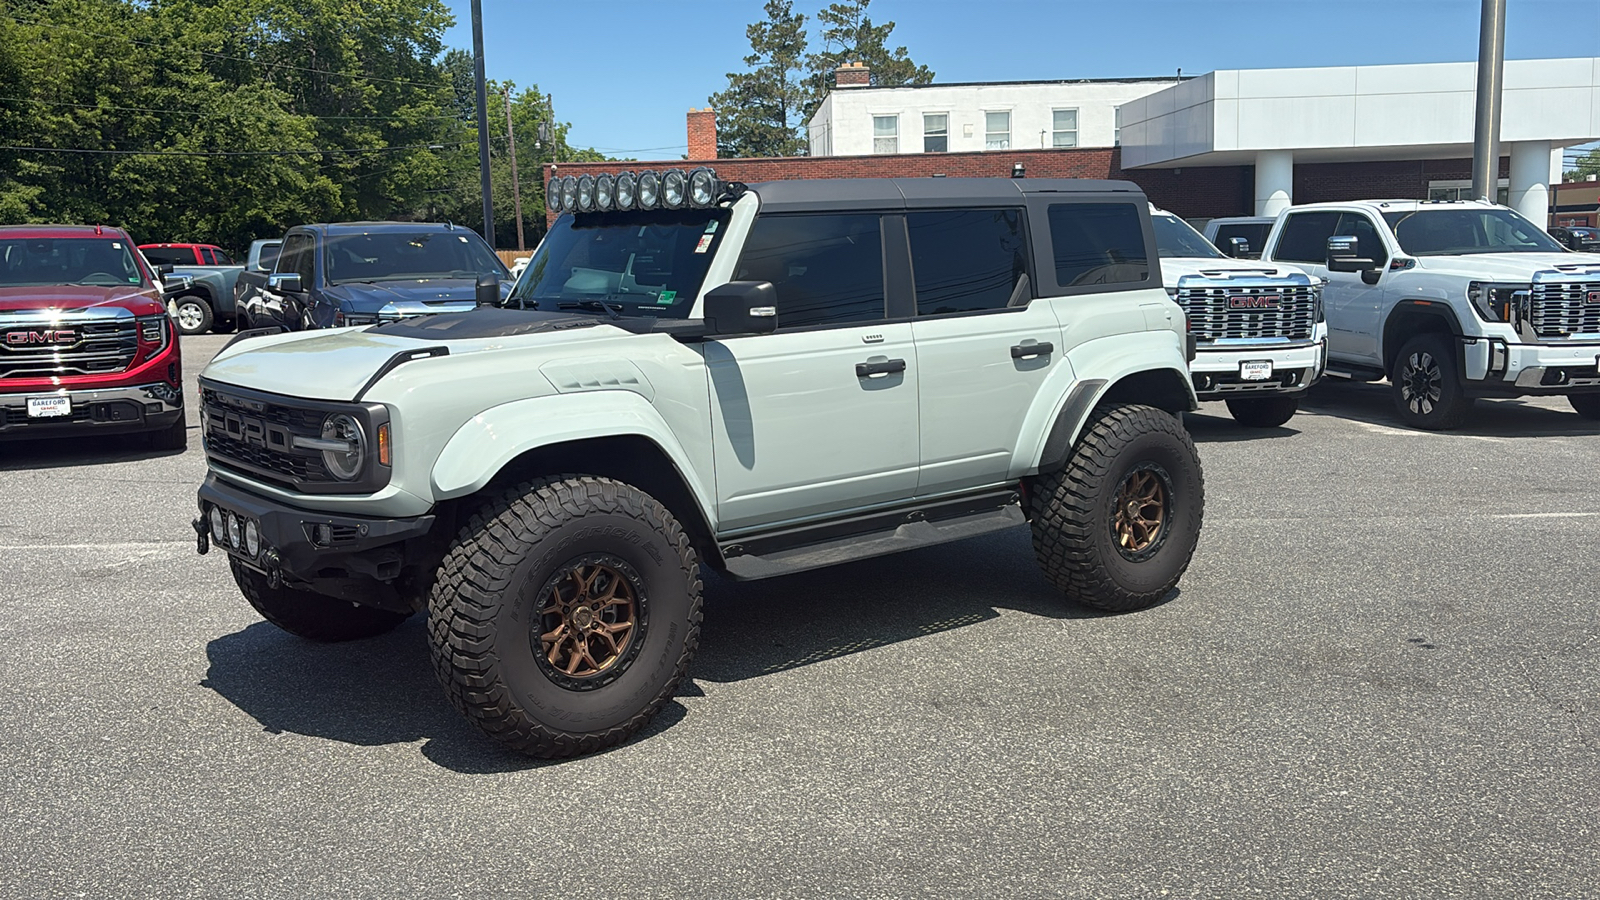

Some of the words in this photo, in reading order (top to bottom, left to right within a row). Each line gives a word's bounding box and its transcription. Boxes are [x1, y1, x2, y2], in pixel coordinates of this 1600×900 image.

[1230, 296, 1281, 309] GMC
[6, 330, 76, 344] GMC
[206, 406, 291, 454] FORD
